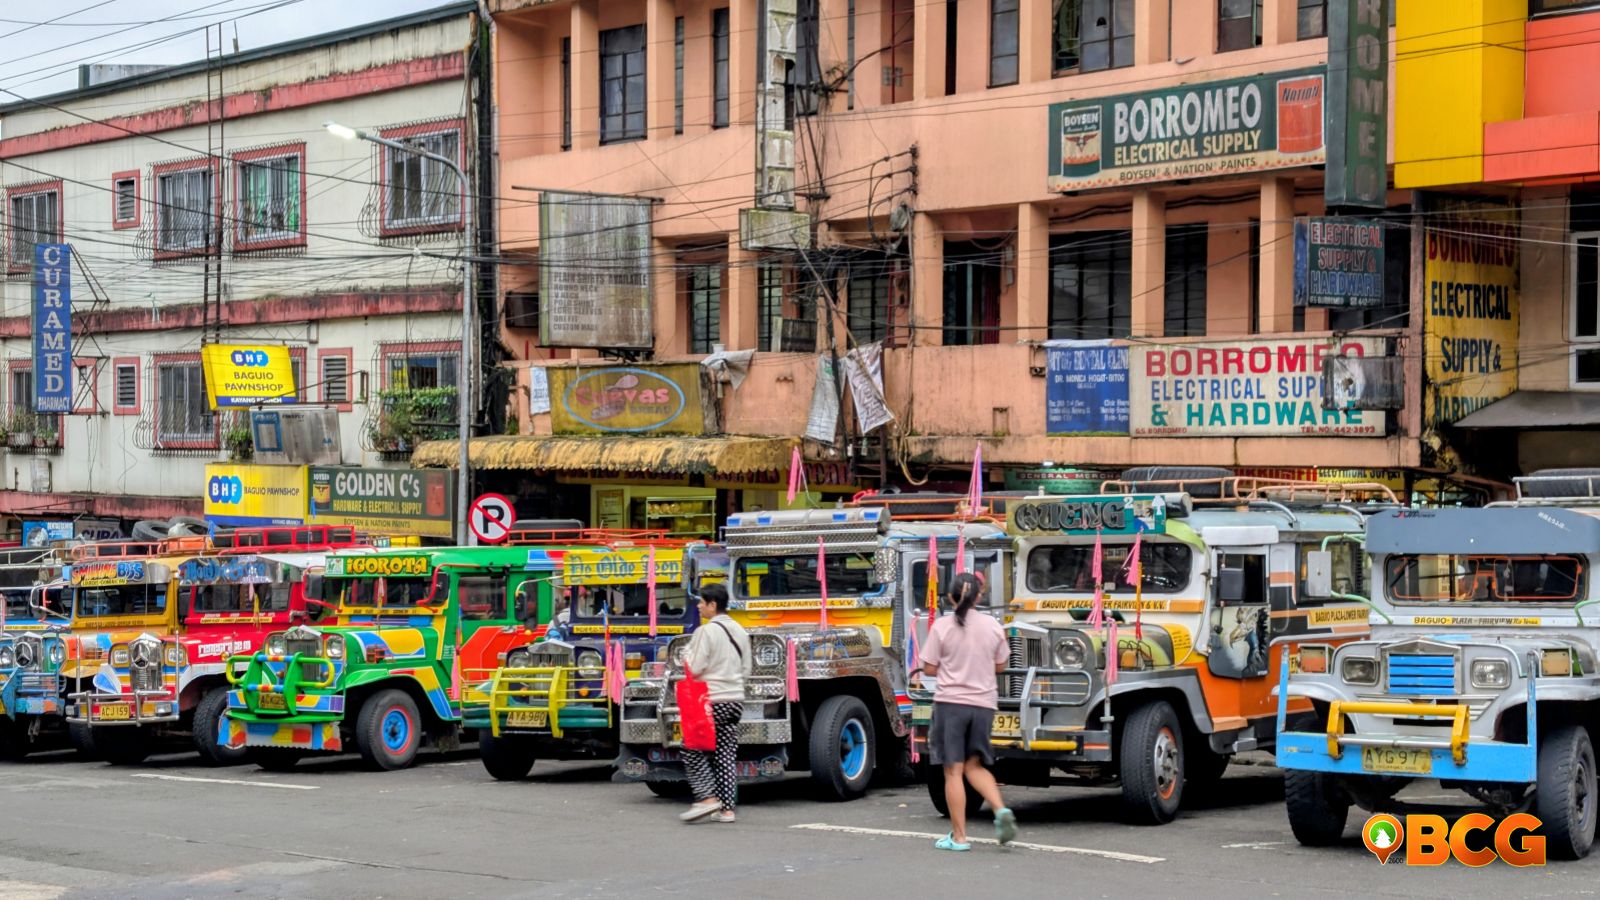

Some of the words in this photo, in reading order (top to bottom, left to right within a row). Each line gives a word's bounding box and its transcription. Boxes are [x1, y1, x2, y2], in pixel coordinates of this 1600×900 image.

[1064, 110, 1099, 127] BOYSEN
[1114, 83, 1262, 145] BORROMEO
[1114, 141, 1199, 167] ELECTRICAL
[1203, 129, 1262, 156] SUPPLY
[1119, 168, 1158, 182] BOYSEN
[1164, 166, 1171, 177] &
[1174, 162, 1212, 176] NATION
[1221, 157, 1256, 170] PAINTS
[1311, 222, 1383, 249] ELECTRICAL
[1428, 221, 1515, 268] BORROMEO
[1318, 247, 1367, 271] SUPPLY
[1367, 250, 1377, 273] &
[1310, 270, 1382, 297] HARDWARE
[1431, 281, 1512, 320] ELECTRICAL
[41, 246, 66, 393] CURAMED
[235, 354, 262, 363] BHF
[1441, 336, 1493, 375] SUPPLY
[1493, 343, 1502, 371] &
[225, 383, 284, 392] PAWNSHOP
[234, 372, 274, 380] BAGUIO
[576, 386, 670, 406] Cuevas
[1151, 377, 1265, 401] ELECTRICAL
[38, 397, 71, 411] PHARMACY
[1151, 404, 1169, 426] &
[1187, 401, 1363, 427] HARDWARE
[335, 472, 395, 497] GOLDEN
[399, 475, 420, 498] C's
[1019, 472, 1068, 480] GENERAL
[212, 483, 237, 497] BHF
[244, 487, 267, 496] BAGUIO
[267, 487, 300, 497] PAWNSHOP
[334, 499, 361, 512] HARDWARE
[368, 500, 399, 514] ELECTRICAL
[400, 502, 422, 515] SUPPLY
[482, 505, 504, 534] P
[1042, 600, 1066, 609] BAGUIO
